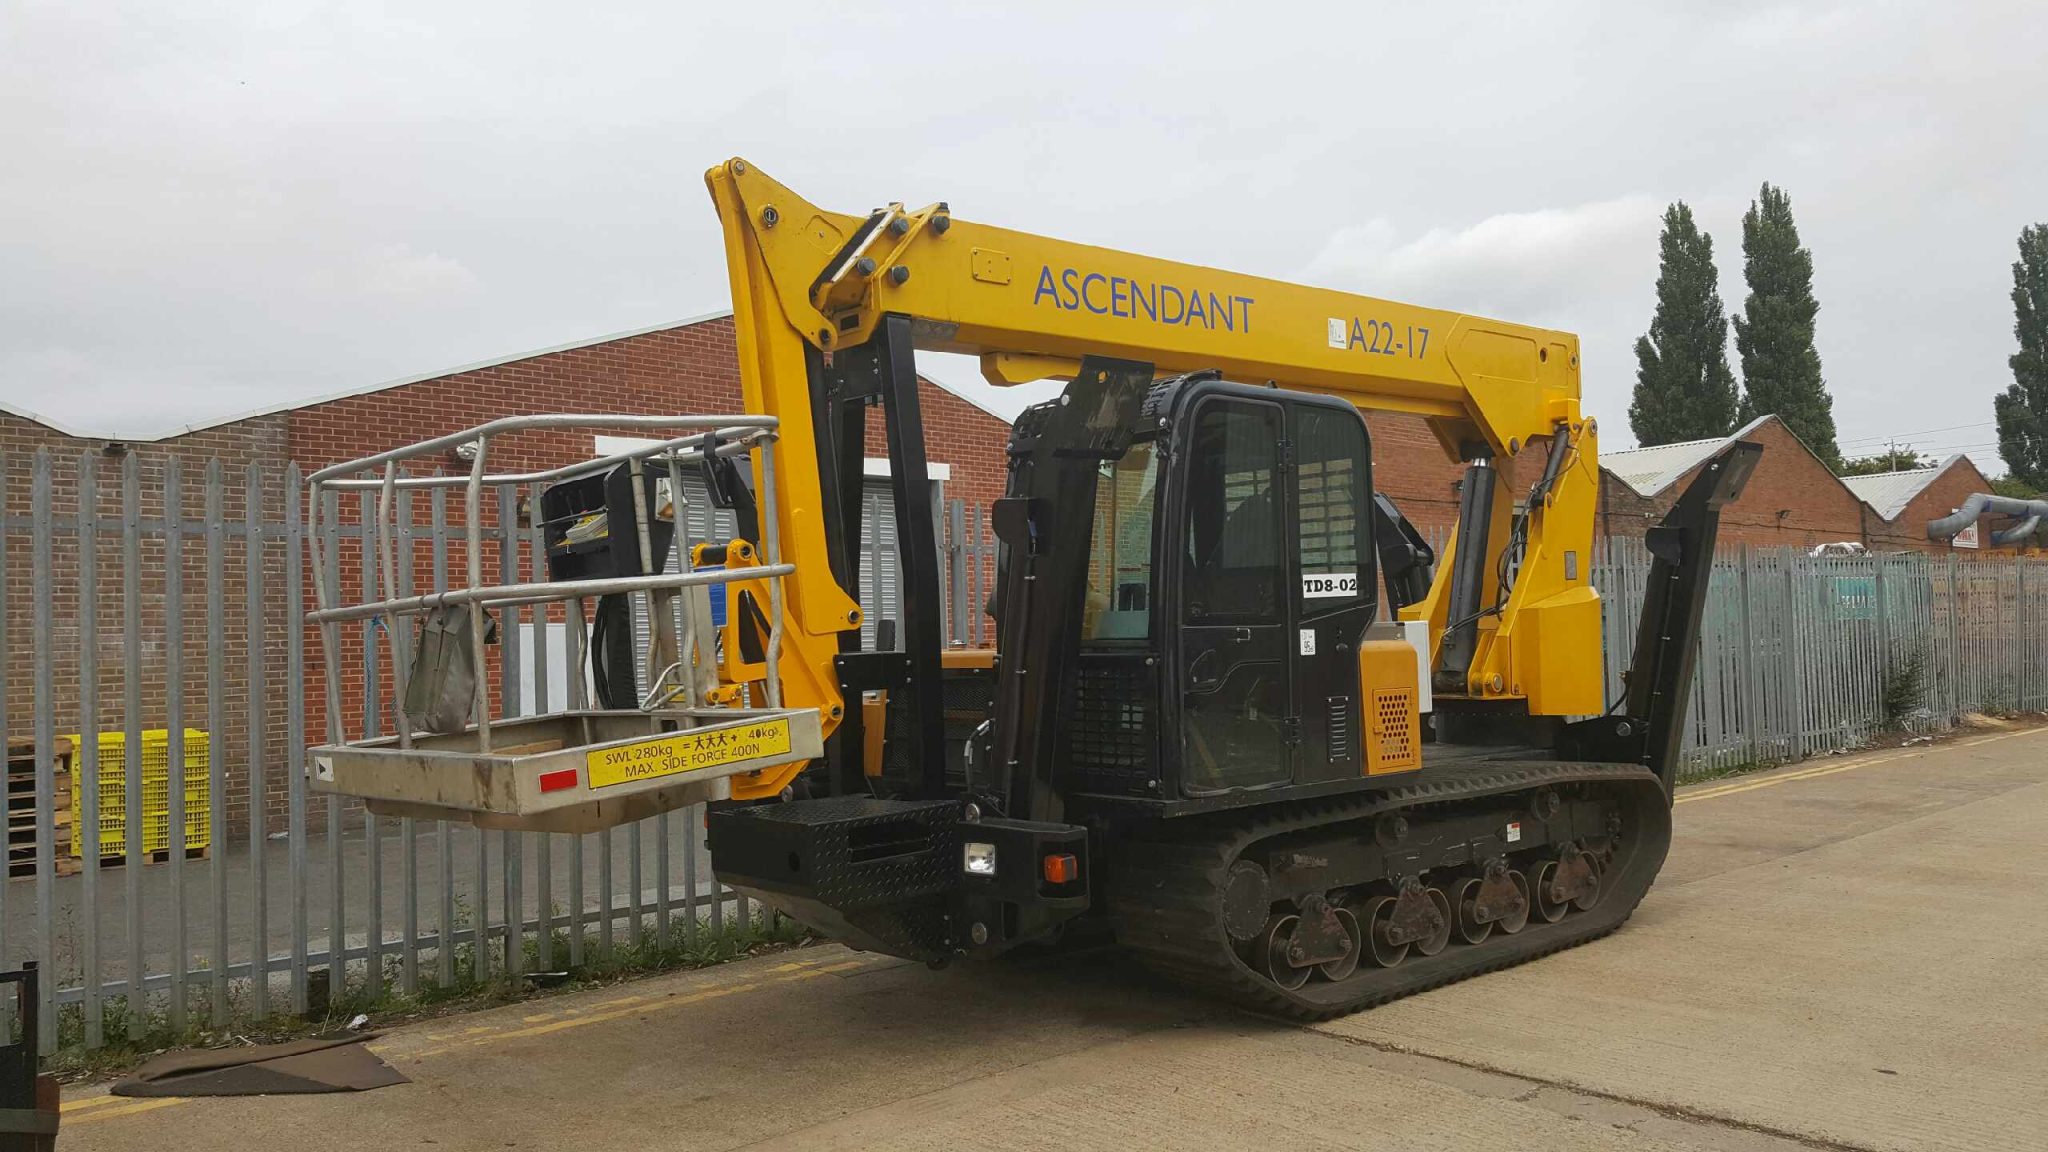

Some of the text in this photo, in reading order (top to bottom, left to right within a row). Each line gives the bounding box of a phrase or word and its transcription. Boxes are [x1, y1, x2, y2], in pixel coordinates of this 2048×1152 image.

[1034, 265, 1255, 334] ASCENDANT
[1349, 317, 1429, 360] A22-17
[1304, 578, 1357, 593] TD8-02
[605, 751, 632, 765] SWL
[635, 744, 673, 760] 280kg
[625, 743, 760, 778] MAX. SIDE FORCE 400N
